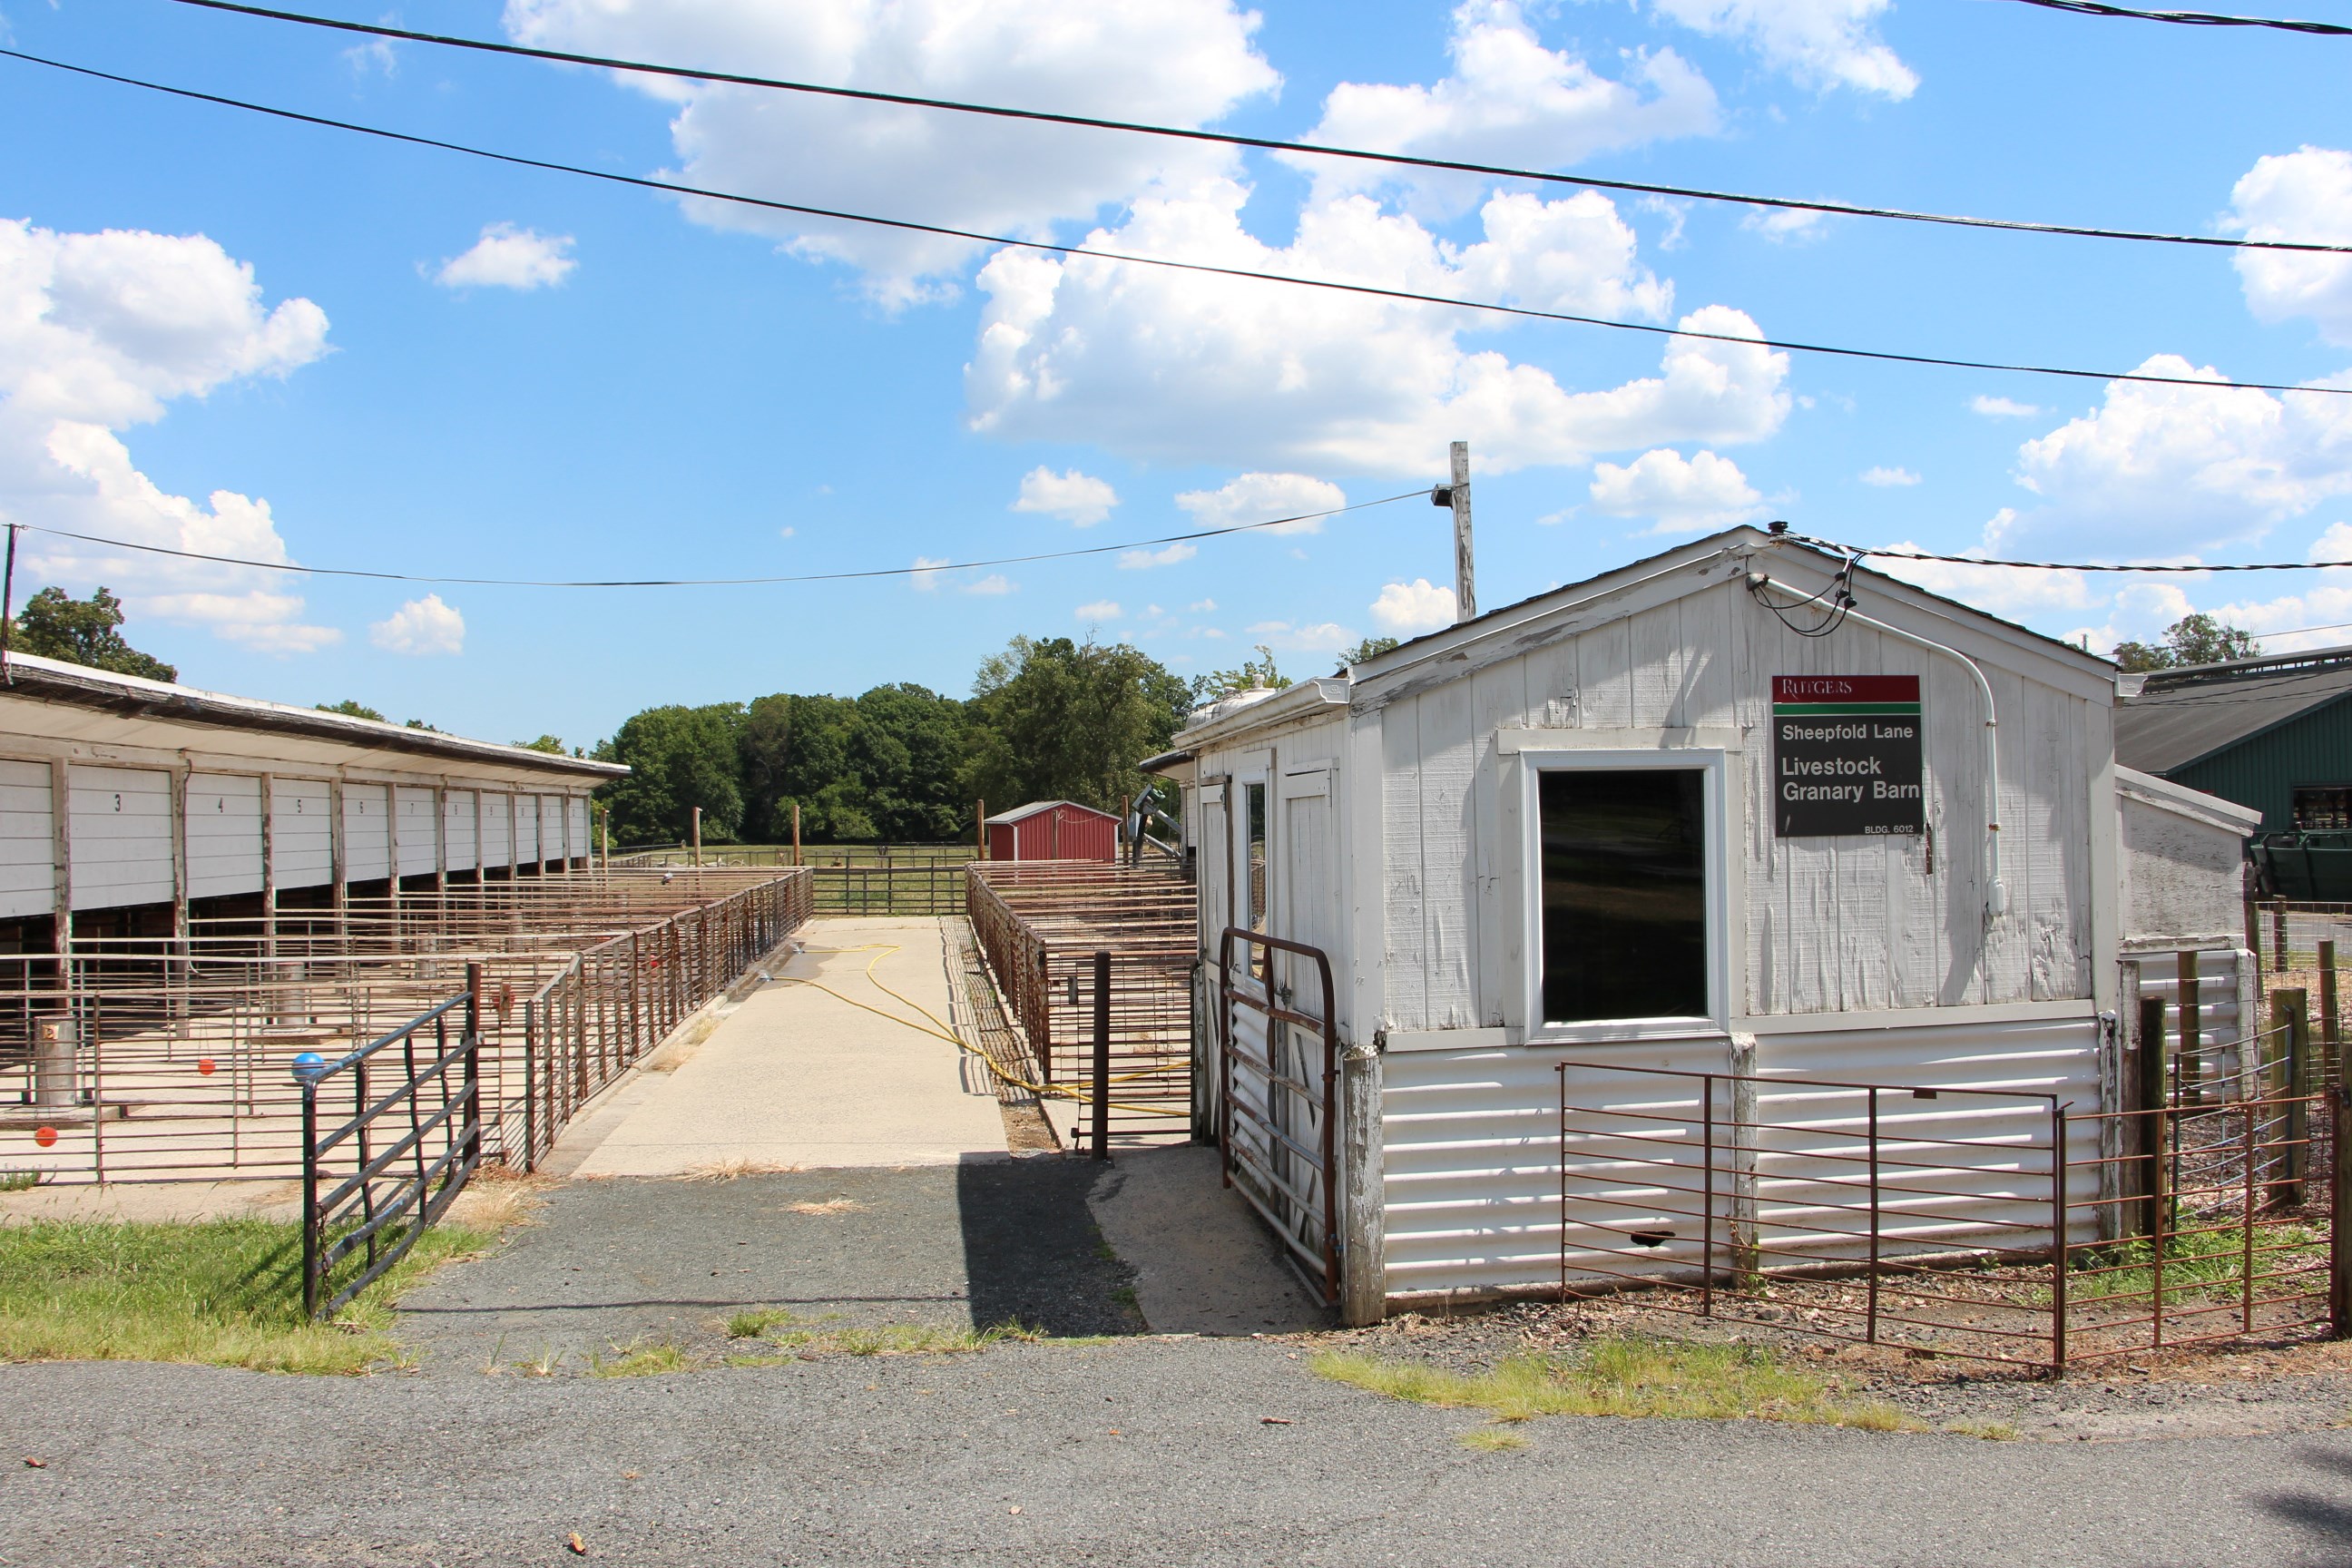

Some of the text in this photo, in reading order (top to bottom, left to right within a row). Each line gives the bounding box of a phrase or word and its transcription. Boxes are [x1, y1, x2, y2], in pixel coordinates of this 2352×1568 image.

[1781, 723, 1914, 743] Sheepfold Lane
[1781, 756, 1882, 776] Livestock
[1782, 780, 1920, 804] Granary Barn
[114, 793, 121, 812] 3
[218, 797, 224, 813] 4
[297, 799, 302, 814] 5
[1865, 825, 1914, 834] BLDG. 6012
